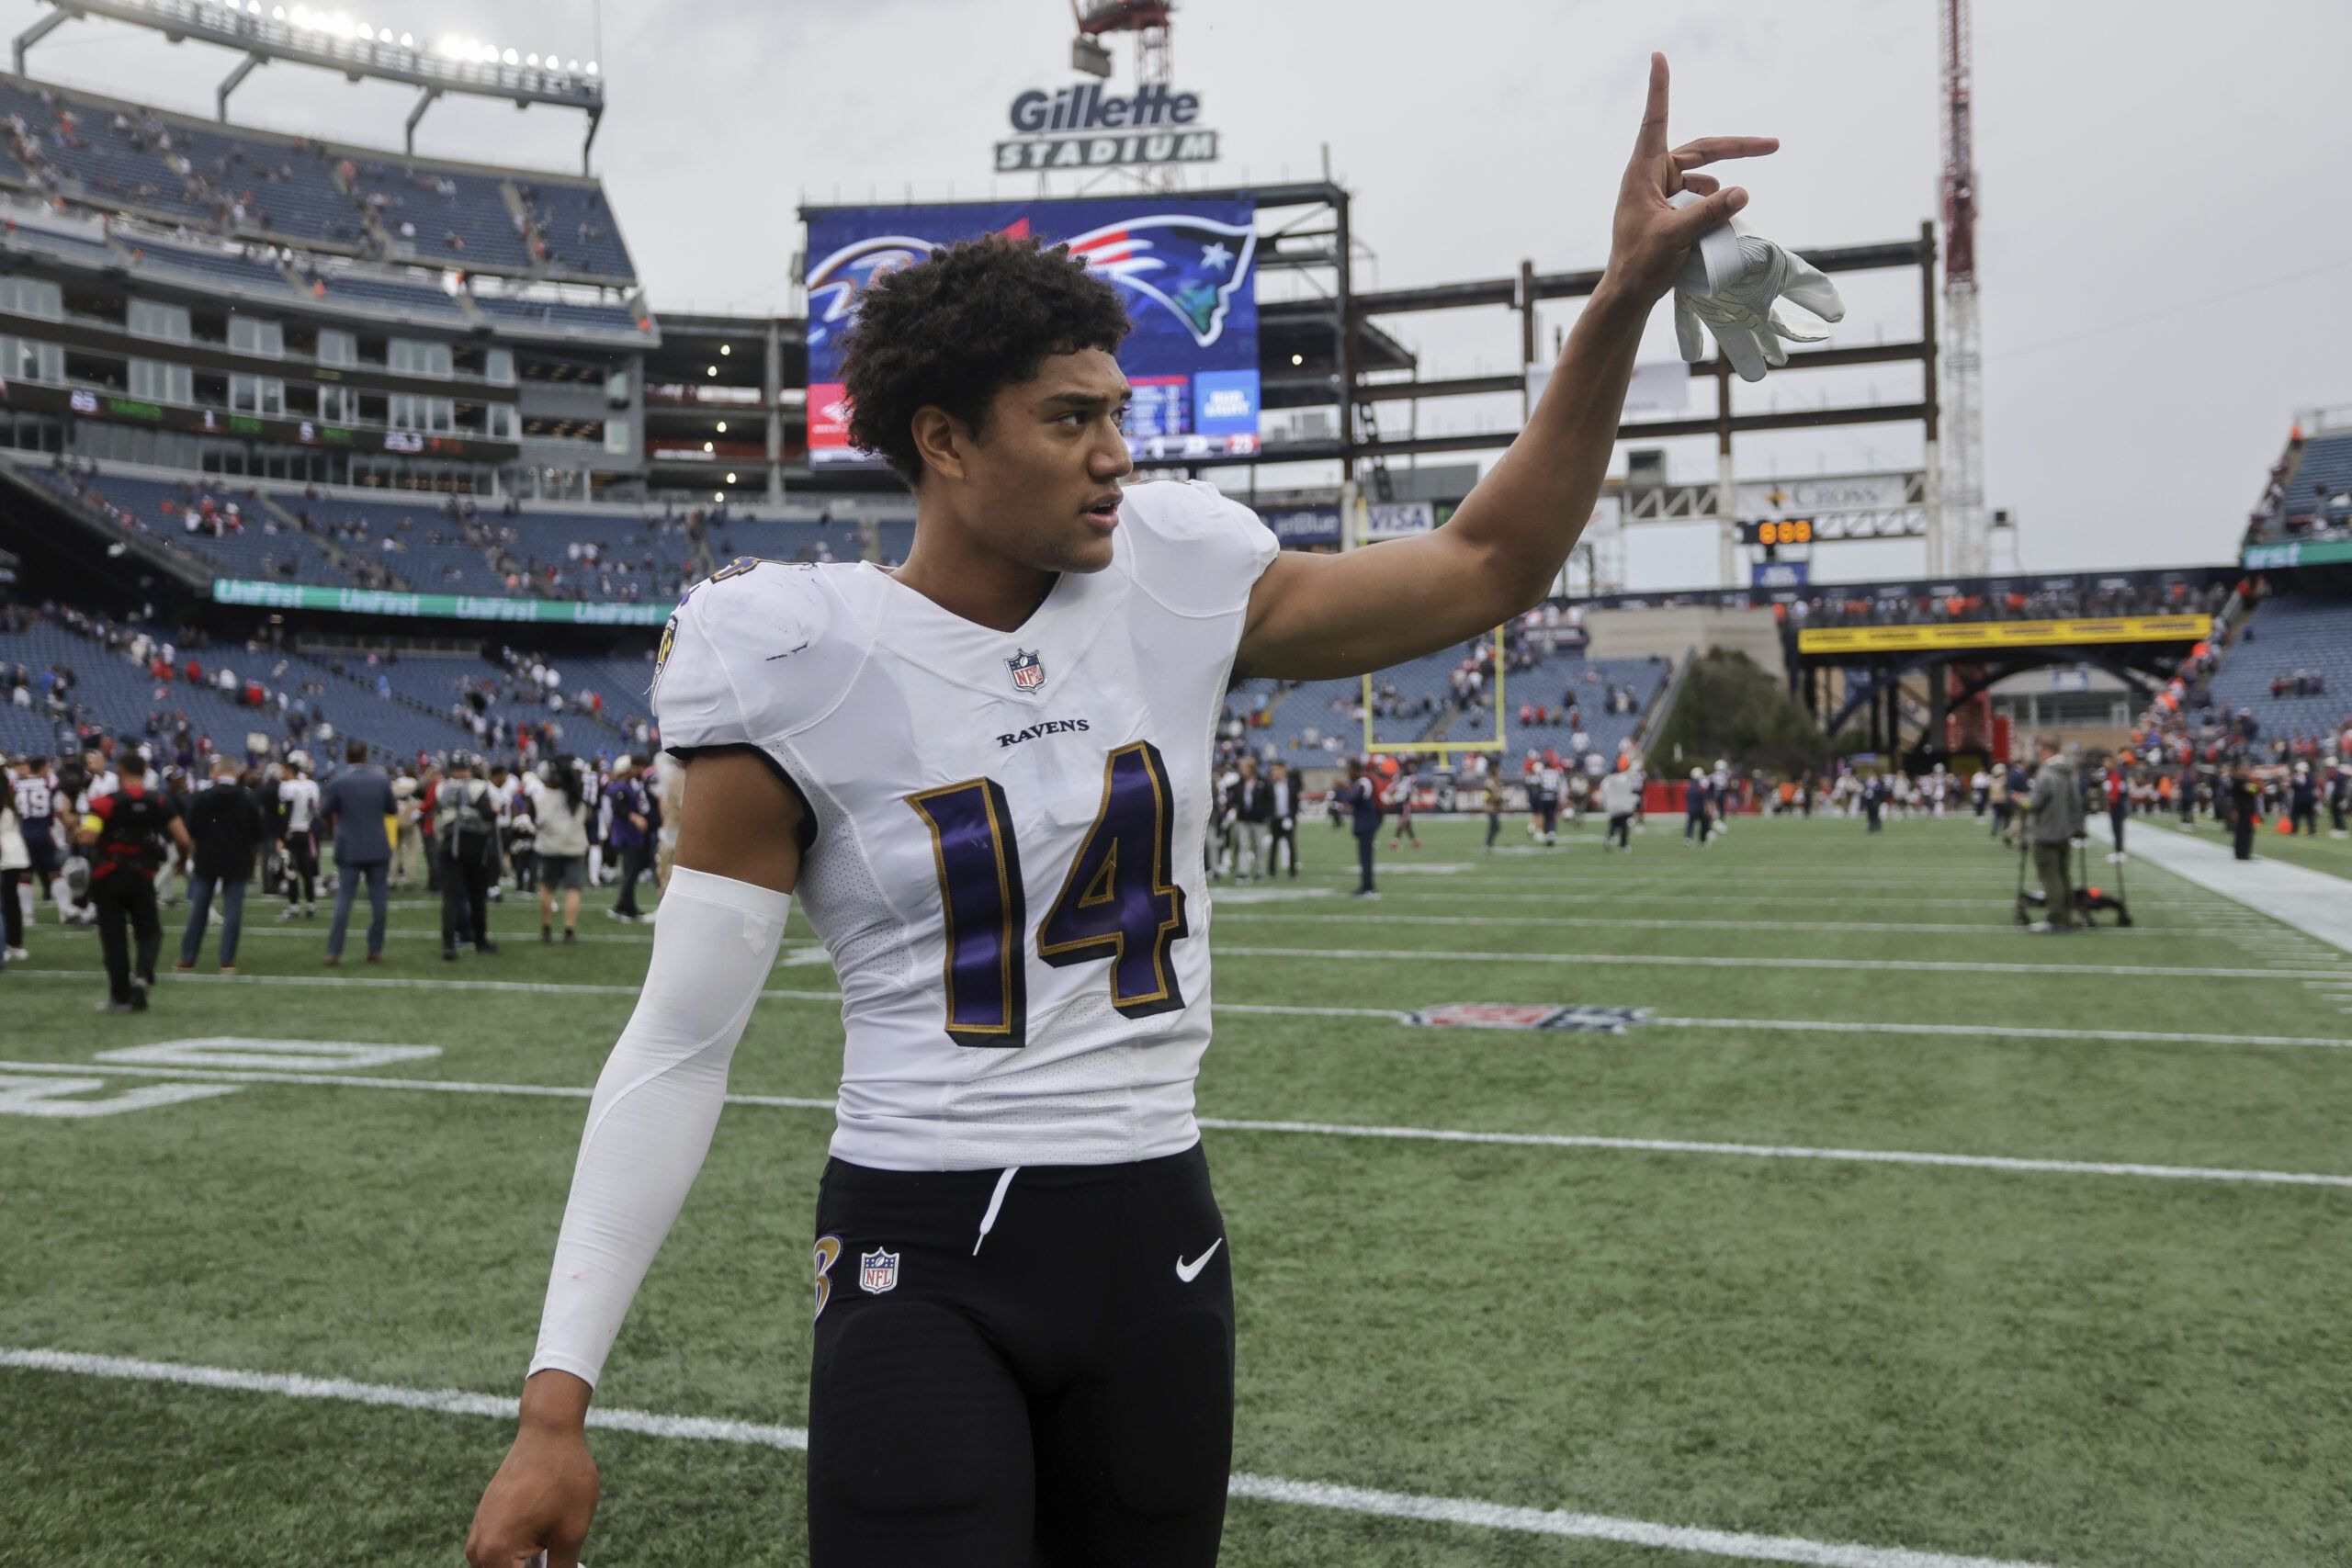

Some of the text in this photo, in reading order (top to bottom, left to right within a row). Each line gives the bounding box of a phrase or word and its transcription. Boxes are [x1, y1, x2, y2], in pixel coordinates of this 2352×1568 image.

[1011, 83, 1199, 132] Gillette
[999, 134, 1215, 169] STADIUM
[1366, 505, 1427, 529] VISA
[996, 719, 1090, 749] RAVENS
[903, 739, 1189, 1049] 14
[865, 1269, 891, 1288] NFL
